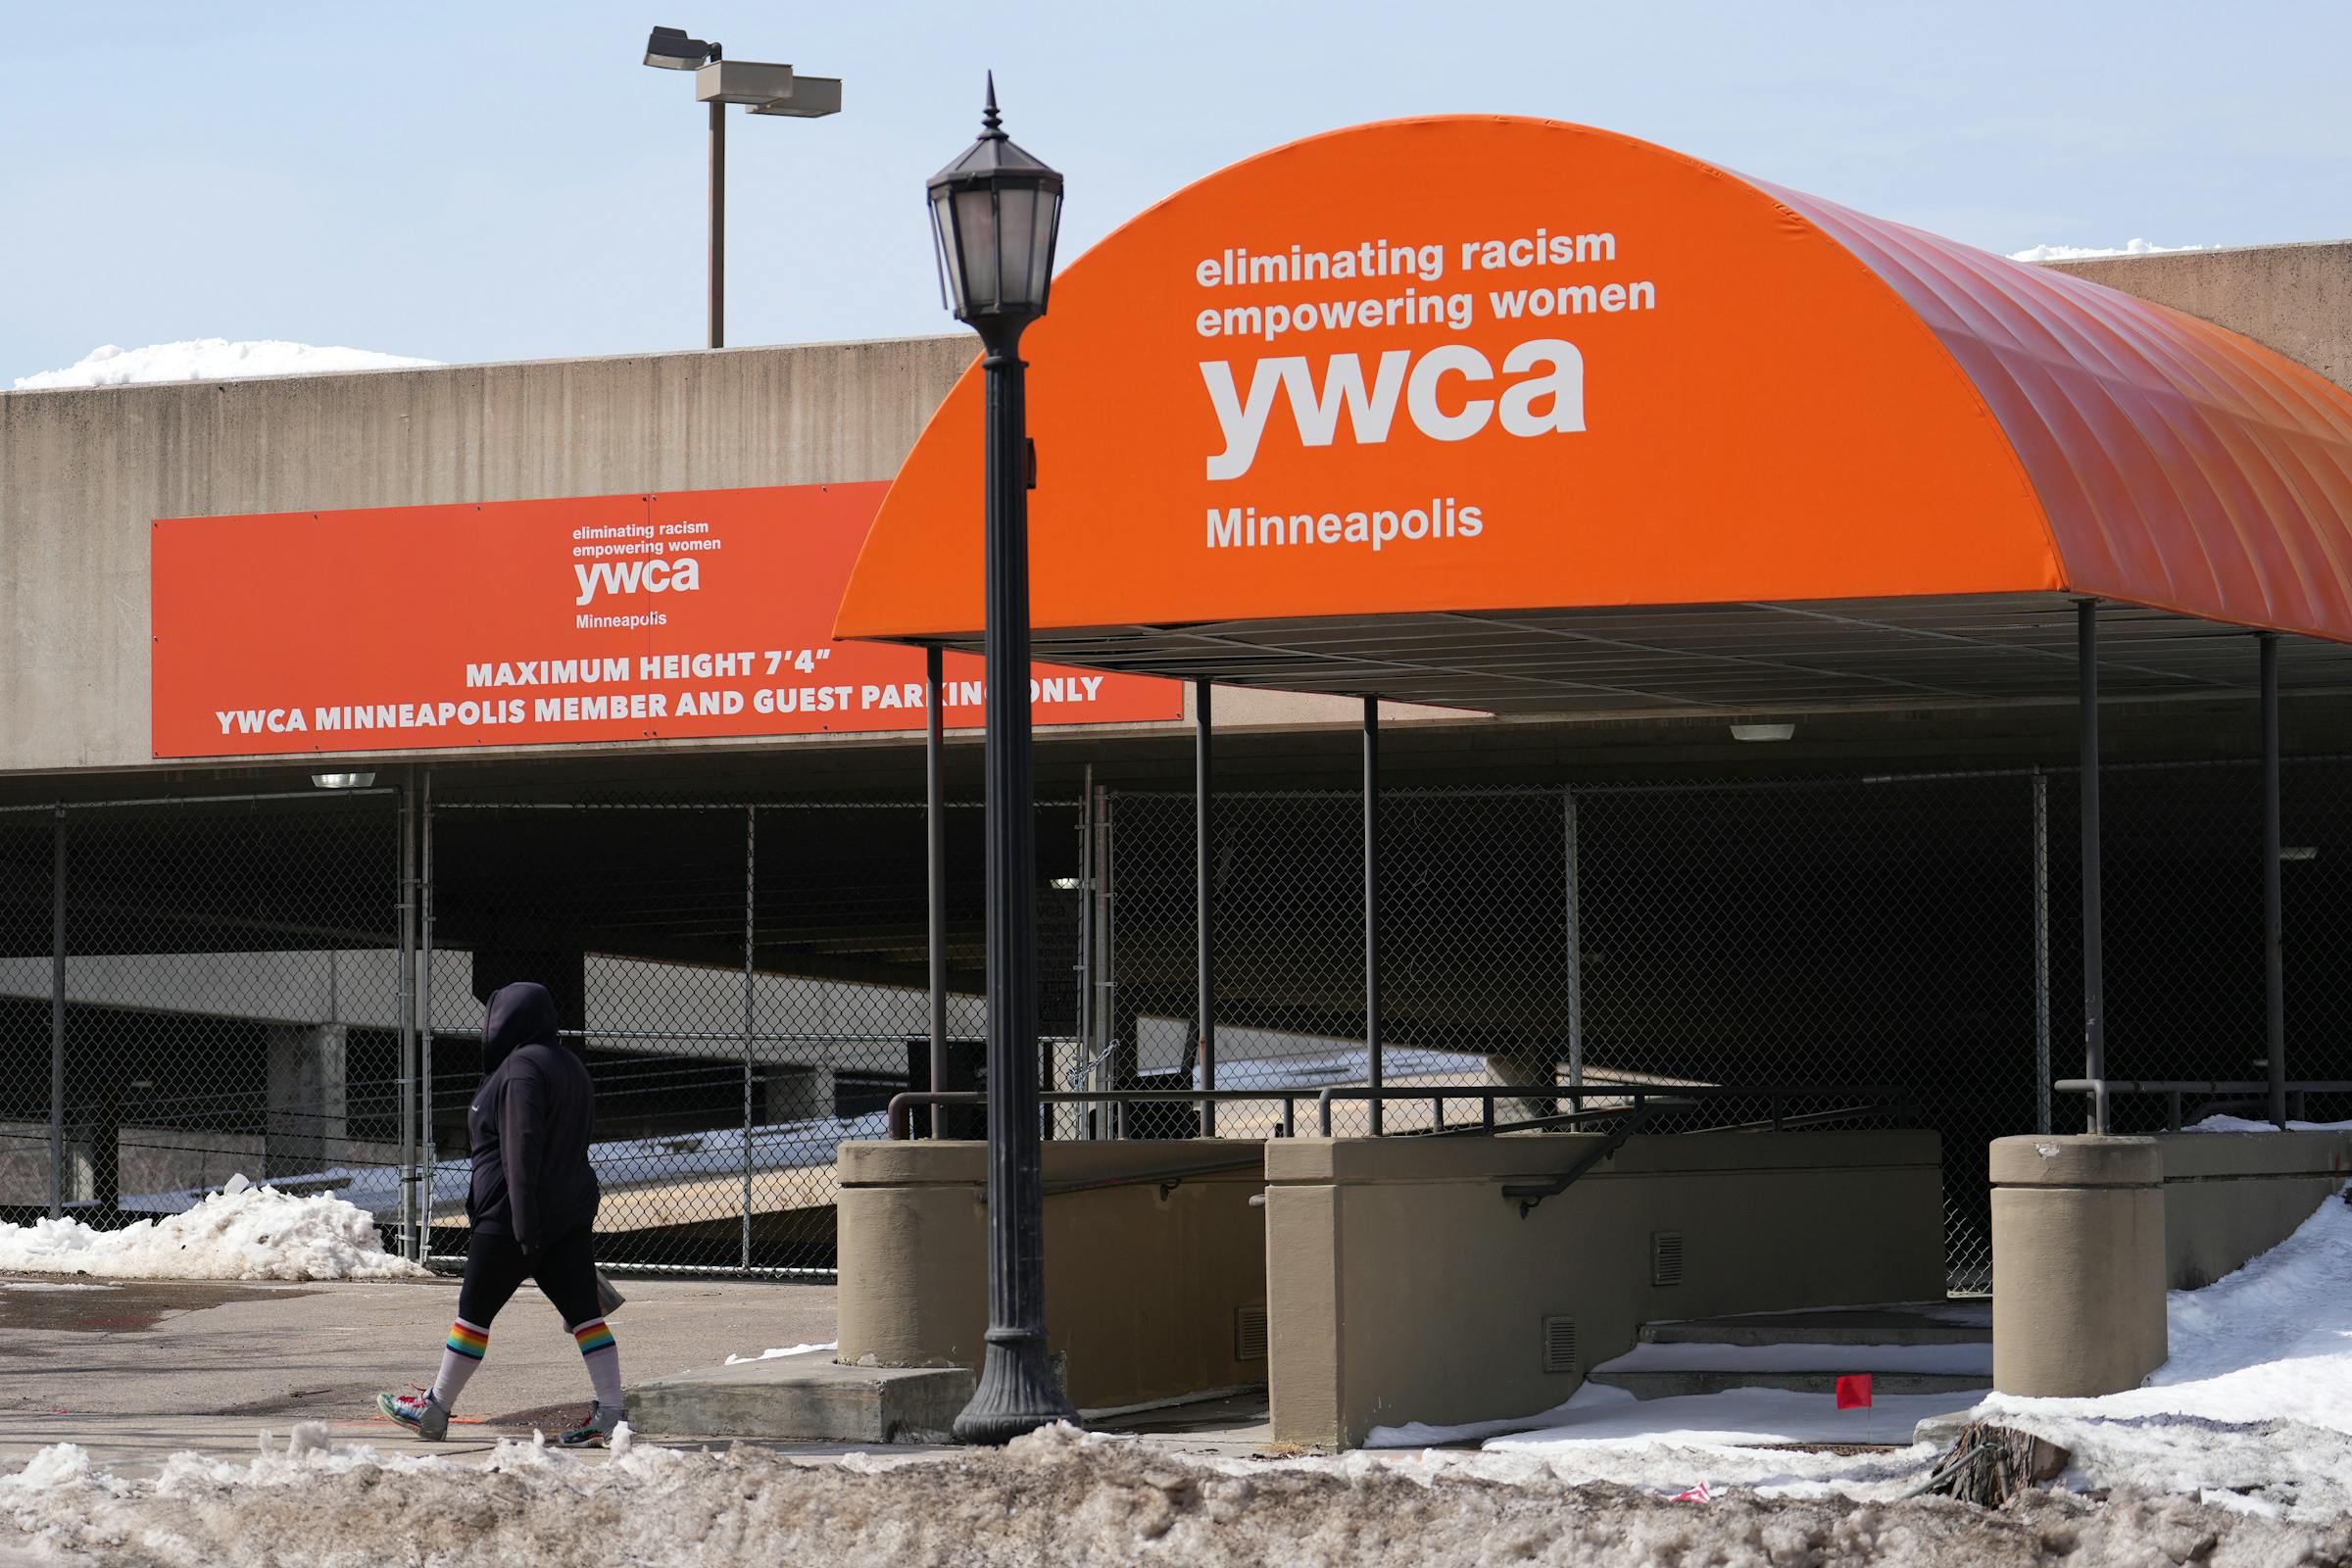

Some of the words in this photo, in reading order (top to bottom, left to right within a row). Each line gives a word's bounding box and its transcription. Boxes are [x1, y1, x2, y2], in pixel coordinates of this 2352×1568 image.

[1196, 238, 1444, 287] eliminating
[1462, 227, 1616, 270] racism
[1196, 287, 1473, 341] empowering
[1490, 280, 1655, 319] women
[1200, 338, 1587, 480] ywca
[572, 523, 655, 540] eliminating
[659, 521, 710, 535] racism
[572, 540, 664, 559] empowering
[668, 539, 721, 552] women
[1206, 498, 1484, 551] Minneapolis
[573, 558, 700, 607] ywca
[575, 612, 667, 630] Minneapolis
[466, 657, 630, 688] MAXIMUM
[640, 651, 756, 681] HEIGHT
[215, 709, 308, 735] YWCA
[315, 700, 526, 731] MINNEAPOLIS
[534, 692, 667, 722] MEMBER
[674, 690, 745, 716] AND
[753, 685, 854, 714] GUEST
[861, 681, 987, 710] PARIN
